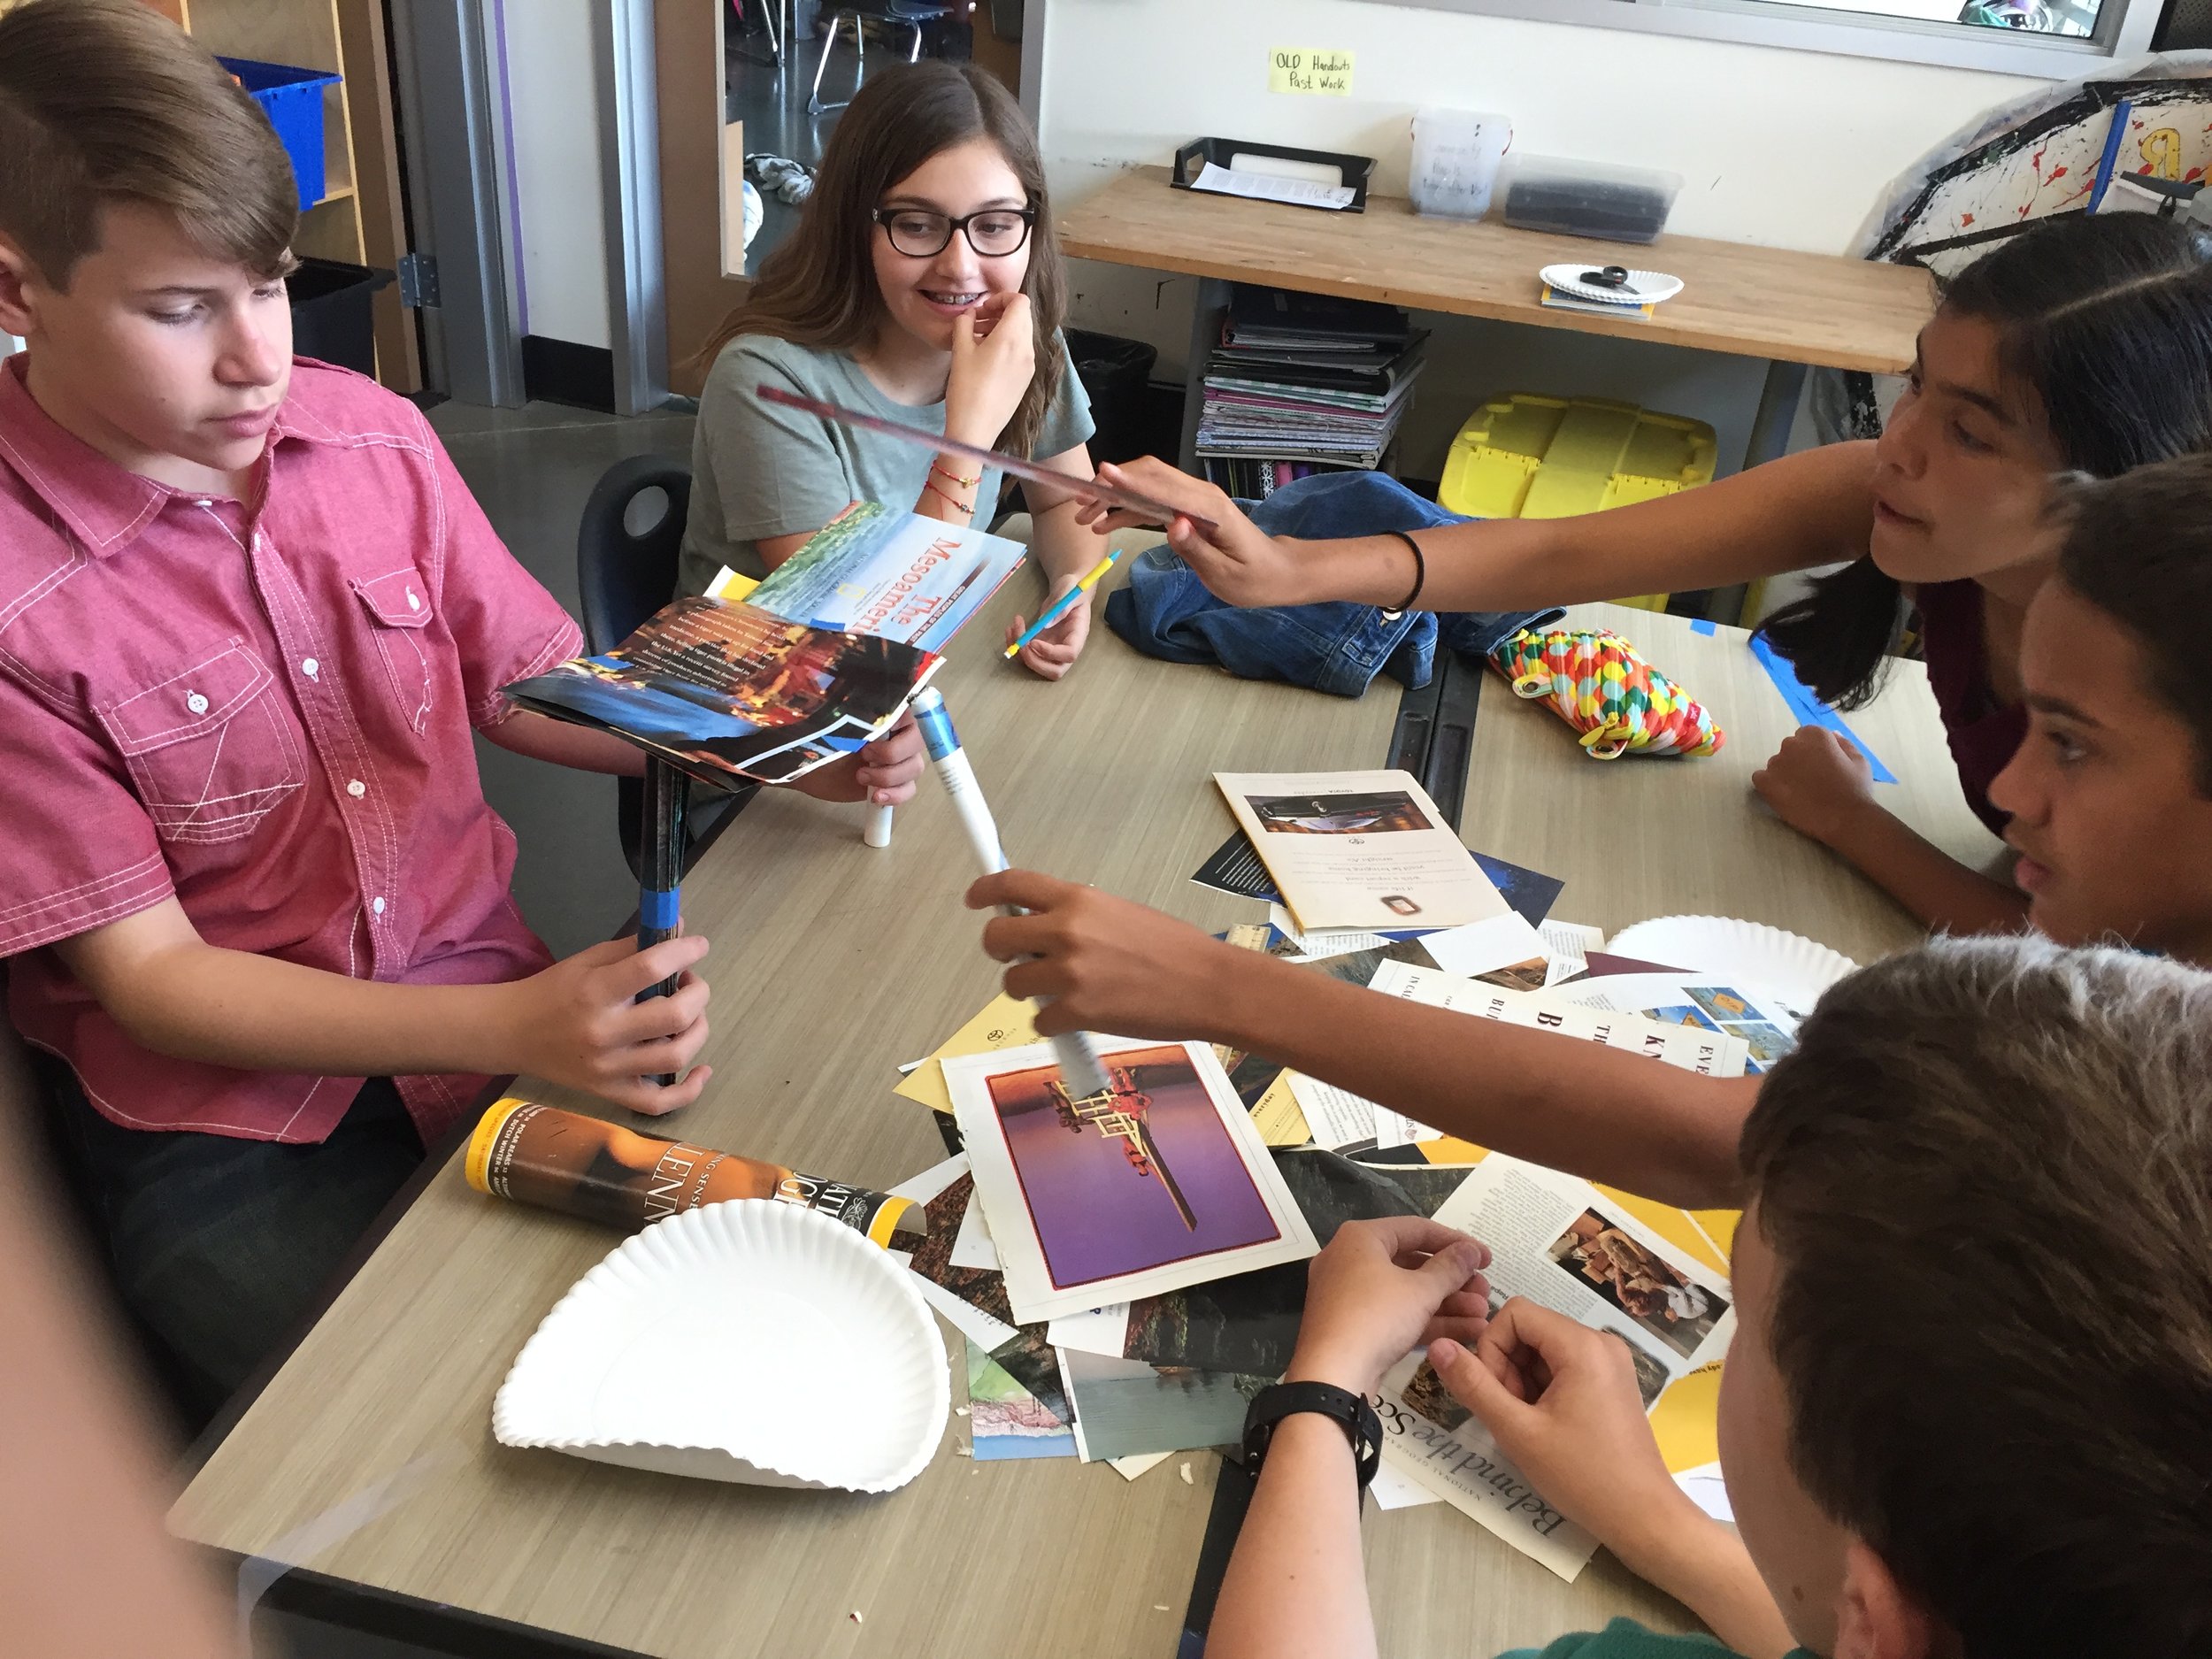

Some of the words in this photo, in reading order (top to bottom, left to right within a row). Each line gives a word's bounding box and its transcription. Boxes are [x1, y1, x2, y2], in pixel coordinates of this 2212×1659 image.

[1276, 52, 1301, 69] OLD
[1312, 55, 1350, 71] Handouts
[1289, 71, 1313, 89] Past
[1319, 76, 1345, 89] Work
[891, 594, 942, 625] The
[503, 1118, 519, 1140] DUTCH
[511, 1123, 526, 1144] POLAR
[495, 1139, 509, 1166] WINTER
[503, 1143, 516, 1166] BEARS
[1411, 1425, 1463, 1461] the
[1432, 1467, 1481, 1502] NATIONAL
[1449, 1452, 1567, 1537] Behind
